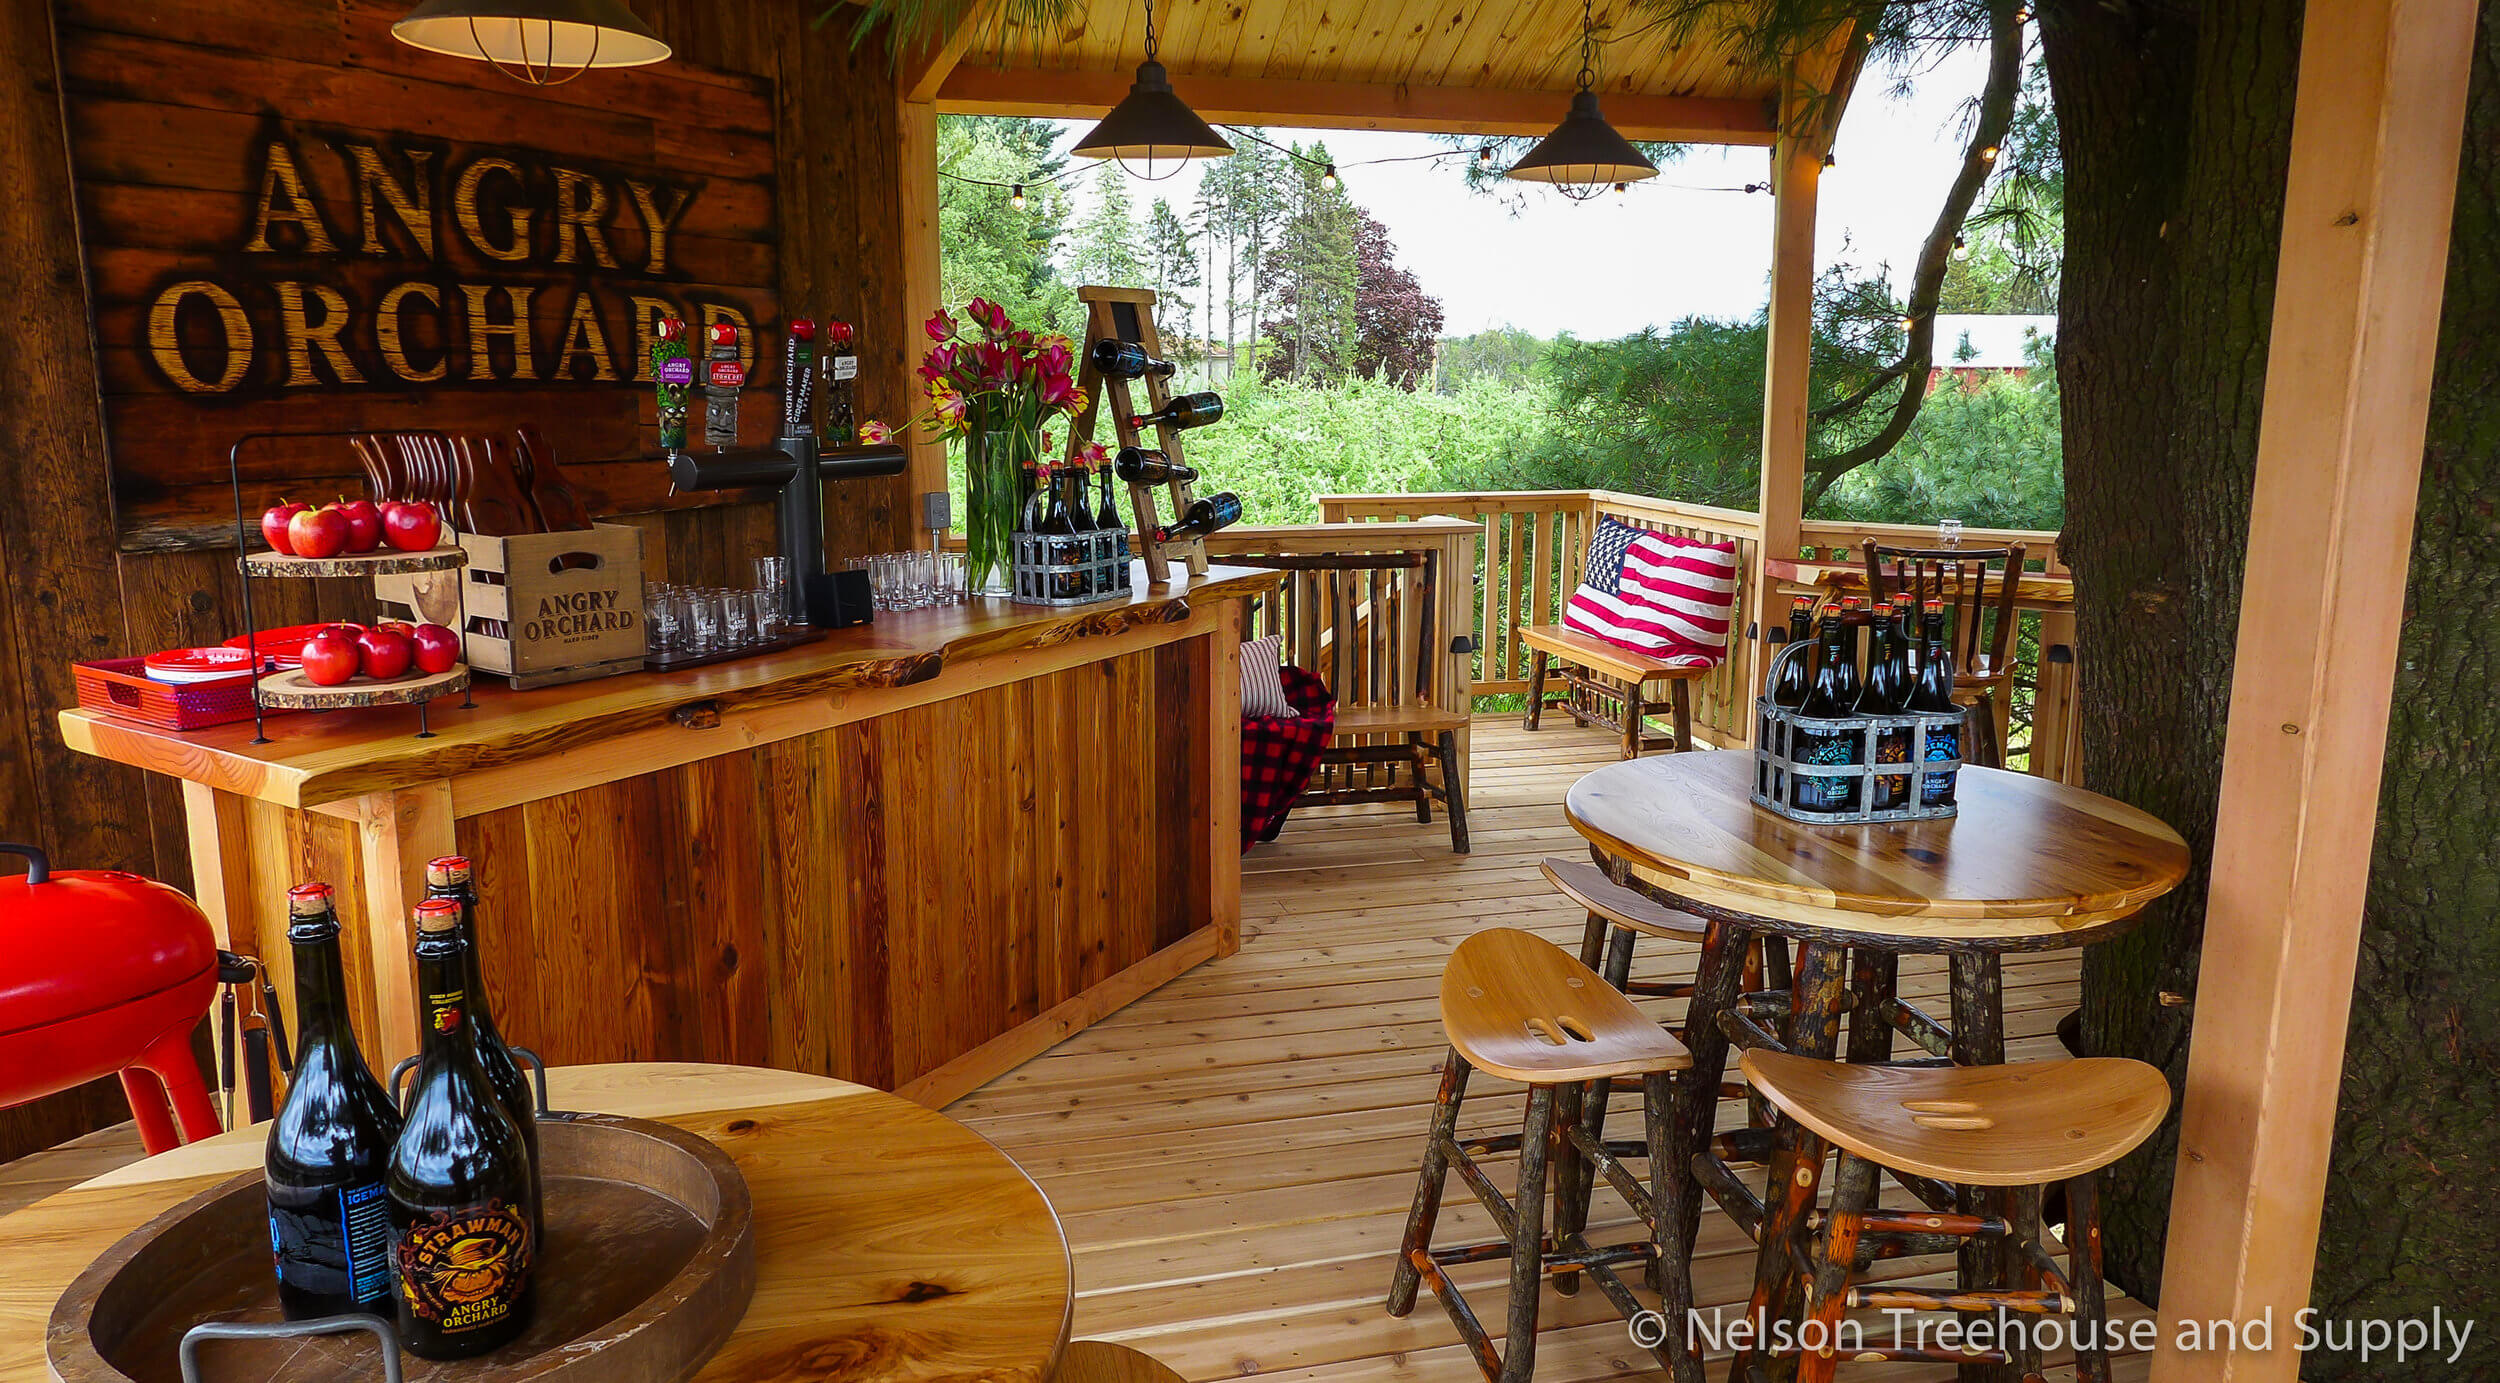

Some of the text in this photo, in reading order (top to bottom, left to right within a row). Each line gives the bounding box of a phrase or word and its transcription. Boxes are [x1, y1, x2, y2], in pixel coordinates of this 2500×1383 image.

[240, 141, 690, 274] ANGRY
[148, 281, 757, 393] ORCHARD
[786, 338, 796, 423] ANGRY ORCHARD
[793, 397, 804, 423] CIDER
[799, 367, 812, 397] MAKER
[538, 590, 619, 618] ANGRY
[524, 611, 634, 641] ORCHARD
[1925, 742, 1952, 753] CEMAN
[418, 1217, 520, 1265] STRAWMAN
[443, 1303, 508, 1328] ORCHARD
[451, 1296, 499, 1317] ANGRY
